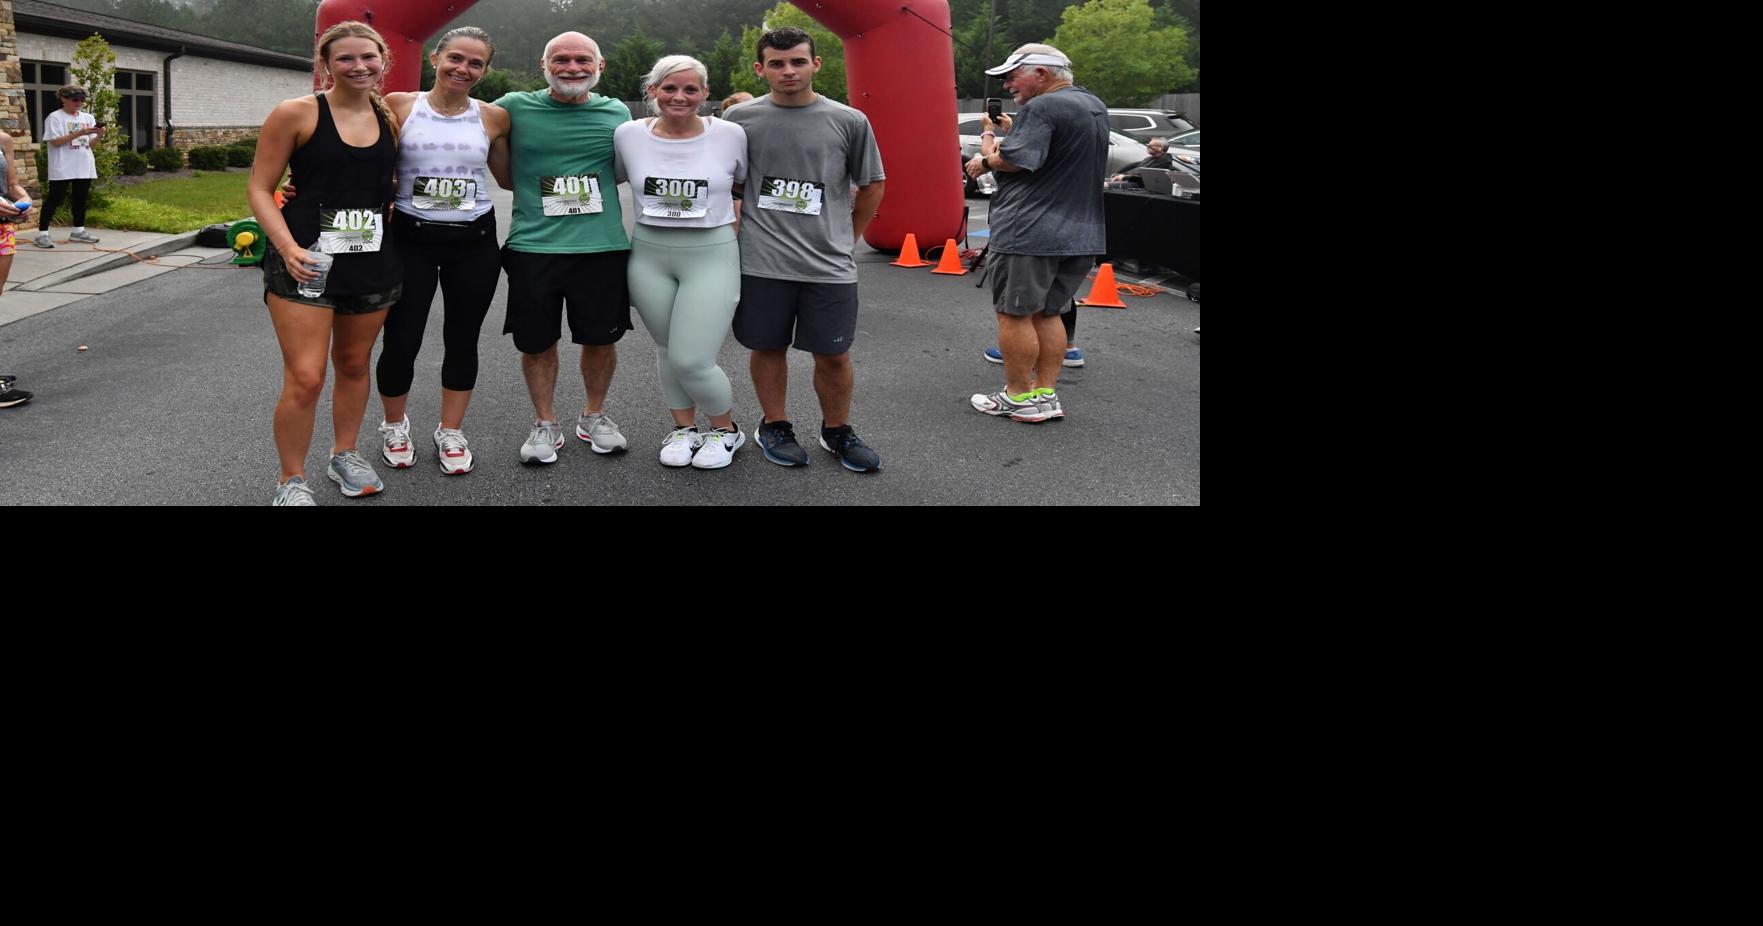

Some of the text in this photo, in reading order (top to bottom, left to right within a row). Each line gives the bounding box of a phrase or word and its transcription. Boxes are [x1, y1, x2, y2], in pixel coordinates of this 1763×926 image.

[424, 178, 466, 198] 403
[553, 175, 589, 195] 401
[655, 178, 696, 197] 300
[771, 179, 814, 200] 398
[333, 210, 375, 230] 402
